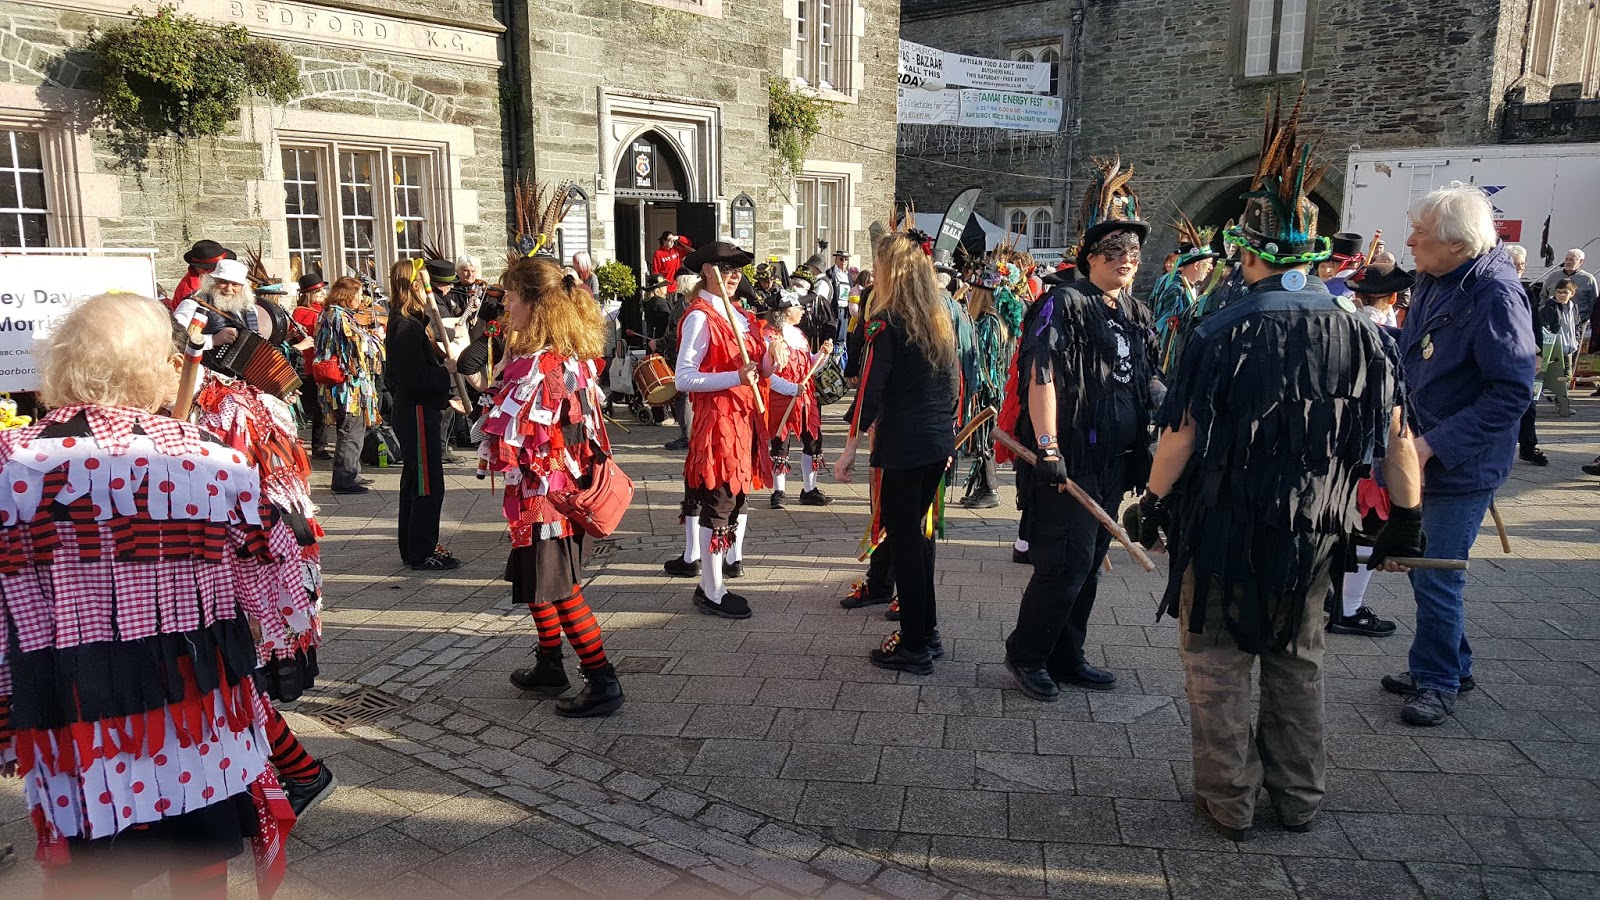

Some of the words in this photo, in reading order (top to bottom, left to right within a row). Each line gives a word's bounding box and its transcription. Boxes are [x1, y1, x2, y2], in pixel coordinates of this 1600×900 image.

[229, 1, 387, 40] BEDFORD
[912, 44, 937, 57] CHURCH
[916, 53, 943, 70] BAZAAR
[959, 57, 983, 66] ARTISAN
[984, 60, 998, 68] FOOD
[903, 64, 921, 74] HALL
[923, 69, 941, 78] THIS
[977, 73, 1000, 81] SATURDAY
[1002, 94, 1028, 105] ENERGY
[1029, 98, 1044, 107] FEST
[941, 224, 962, 241] HALL
[0, 293, 25, 309] ey
[34, 289, 73, 308] Day
[0, 315, 54, 332] Morri
